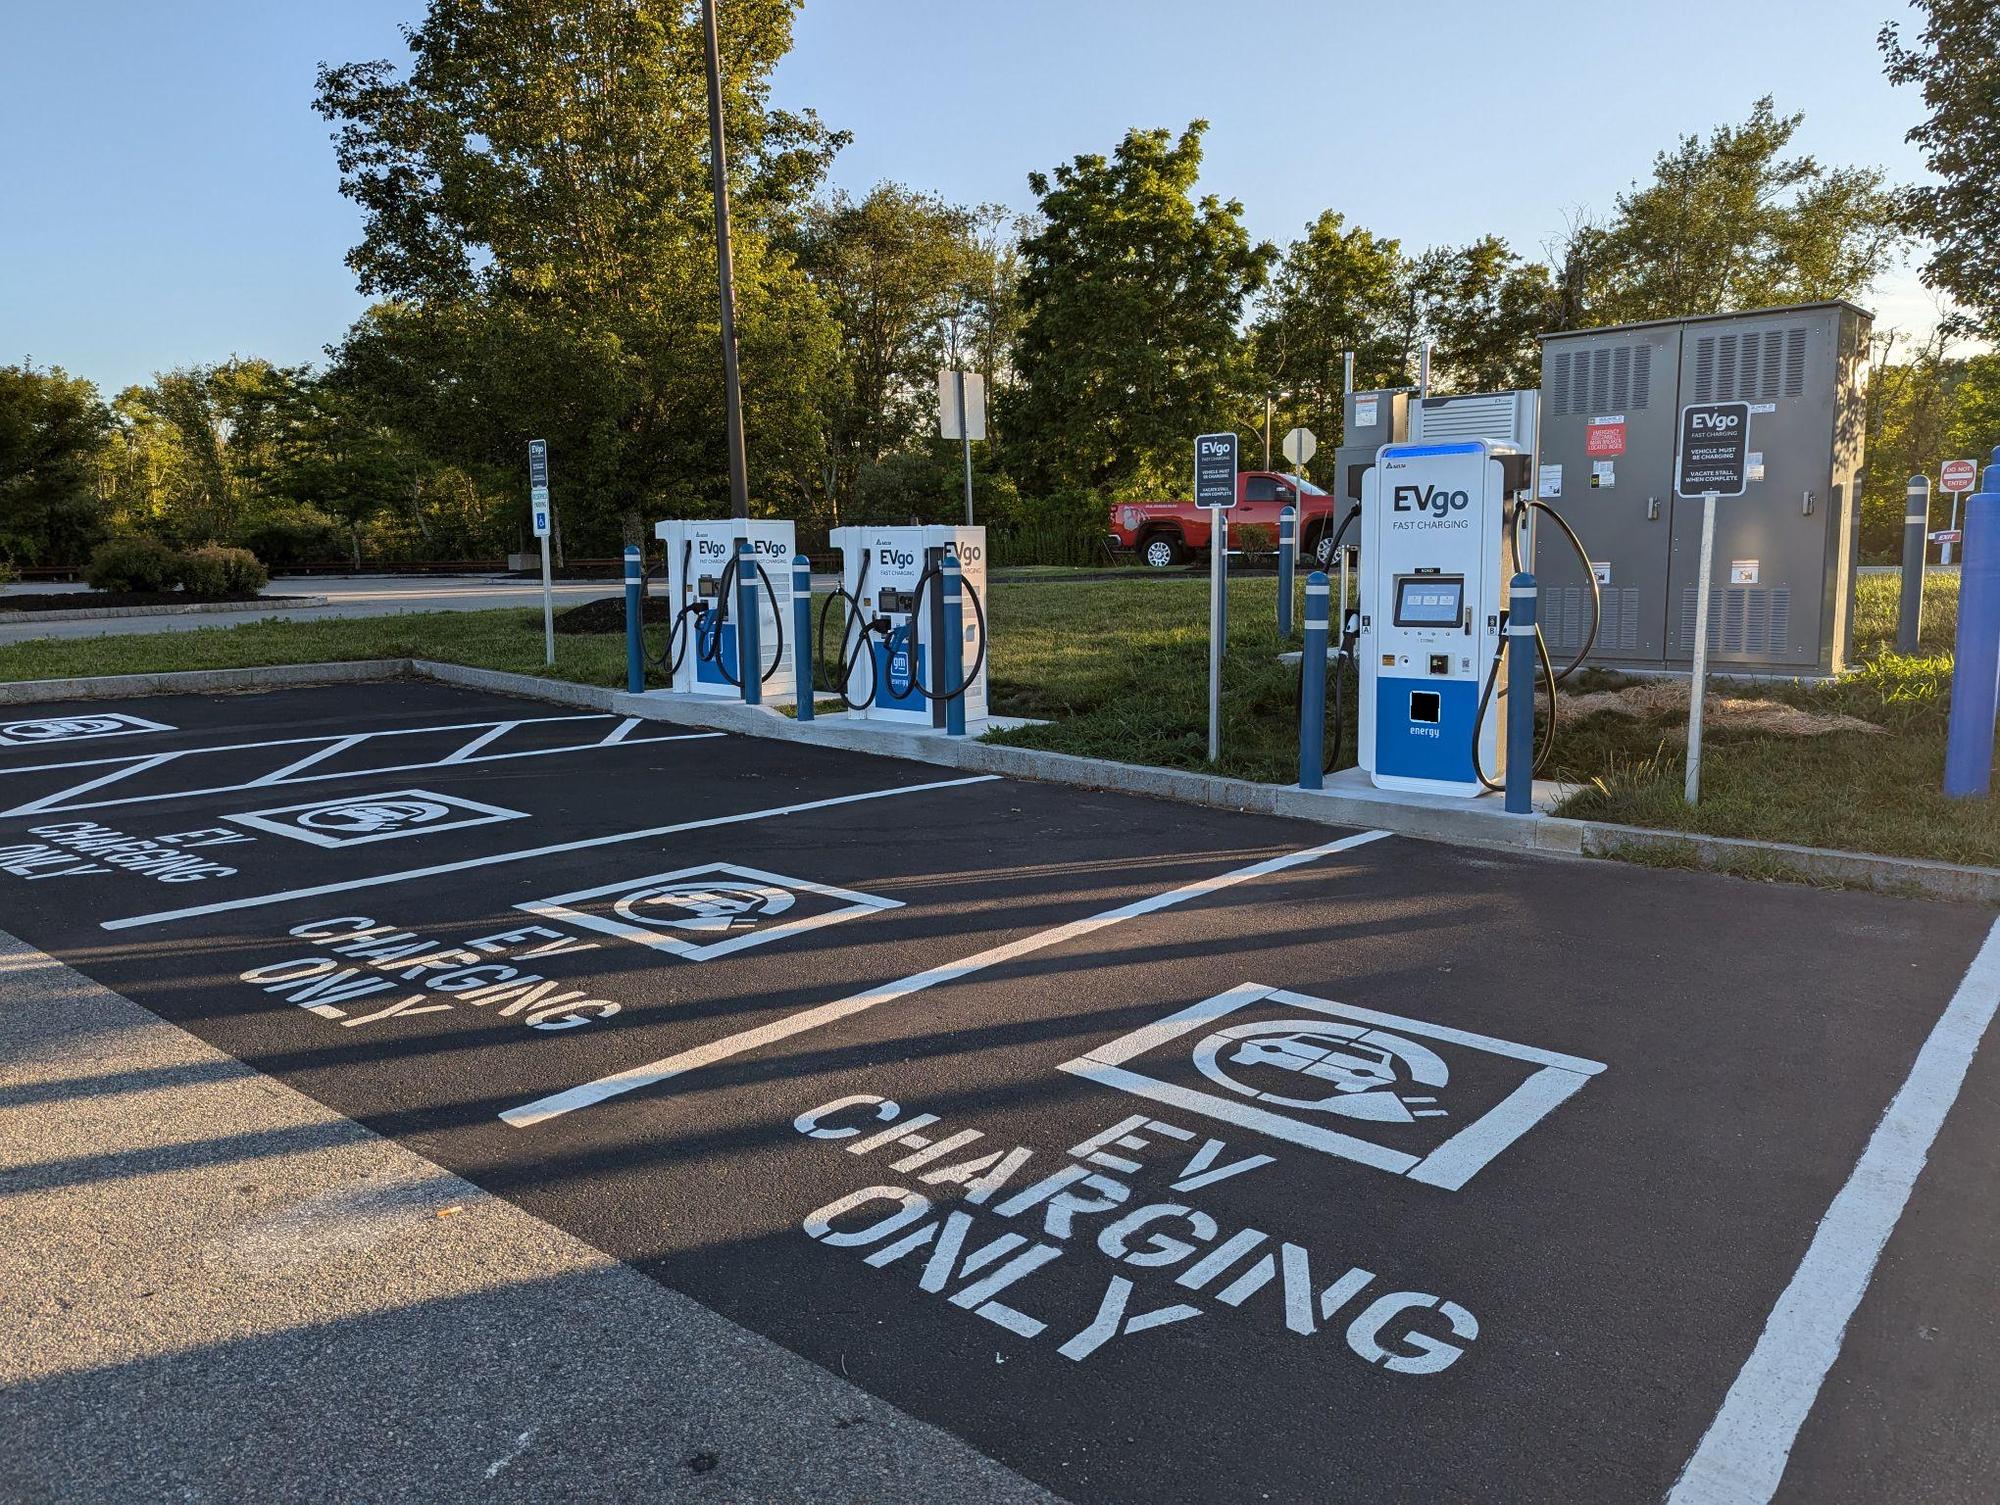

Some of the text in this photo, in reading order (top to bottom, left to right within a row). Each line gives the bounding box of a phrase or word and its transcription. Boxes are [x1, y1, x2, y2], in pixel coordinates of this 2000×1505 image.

[1692, 413, 1738, 430] EVgo
[531, 445, 544, 455] EVgo
[1201, 441, 1230, 456] EVgo
[1394, 484, 1469, 518] EVgo
[1393, 519, 1469, 530] FAST CHARGING
[1938, 533, 1956, 541] EXIT
[699, 540, 726, 558] EVgo
[754, 540, 786, 558] EVgo
[880, 549, 914, 569] EVgo
[944, 541, 981, 565] EVgo
[893, 657, 906, 670] gm
[1410, 727, 1440, 739] energy
[154, 827, 258, 848] EV
[0, 844, 114, 880] ONLY
[27, 821, 238, 883] CHARGING
[464, 925, 602, 961] EV
[288, 916, 622, 1031] CHARGING
[239, 957, 454, 1028] ONLY
[1066, 1113, 1277, 1193] EV
[793, 1094, 1480, 1375] CHARGING
[801, 1185, 1205, 1362] ONLY
